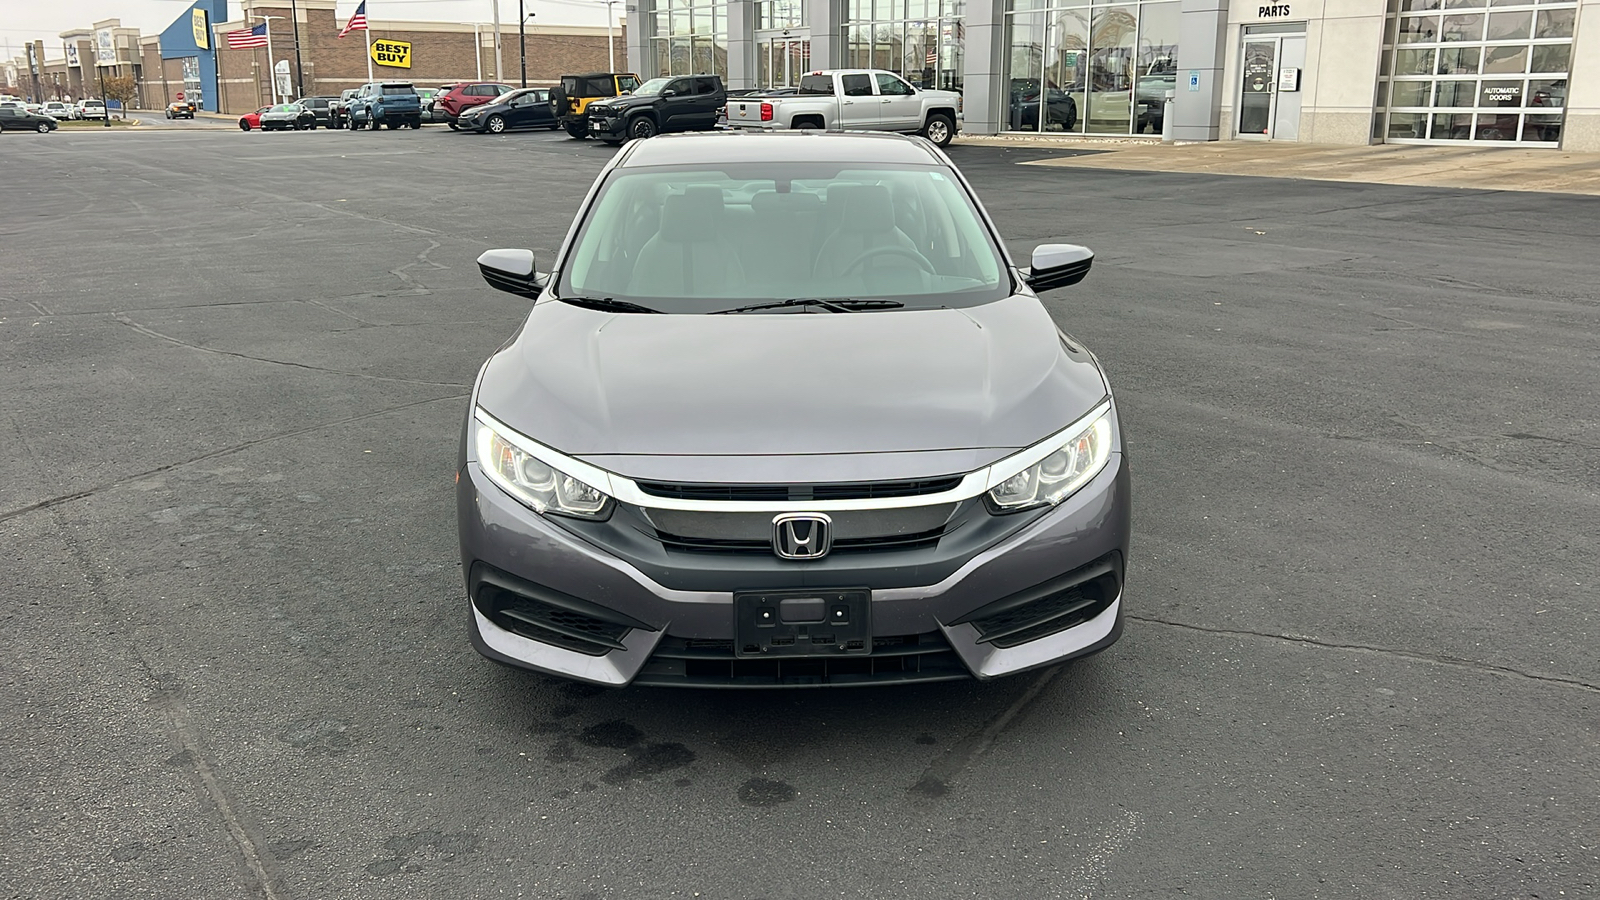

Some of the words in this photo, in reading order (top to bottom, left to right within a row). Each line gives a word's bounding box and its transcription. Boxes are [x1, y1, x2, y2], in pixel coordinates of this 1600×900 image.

[1258, 5, 1290, 18] PARTS
[193, 14, 205, 29] BEST
[376, 43, 409, 54] BEST
[377, 52, 406, 63] BUY
